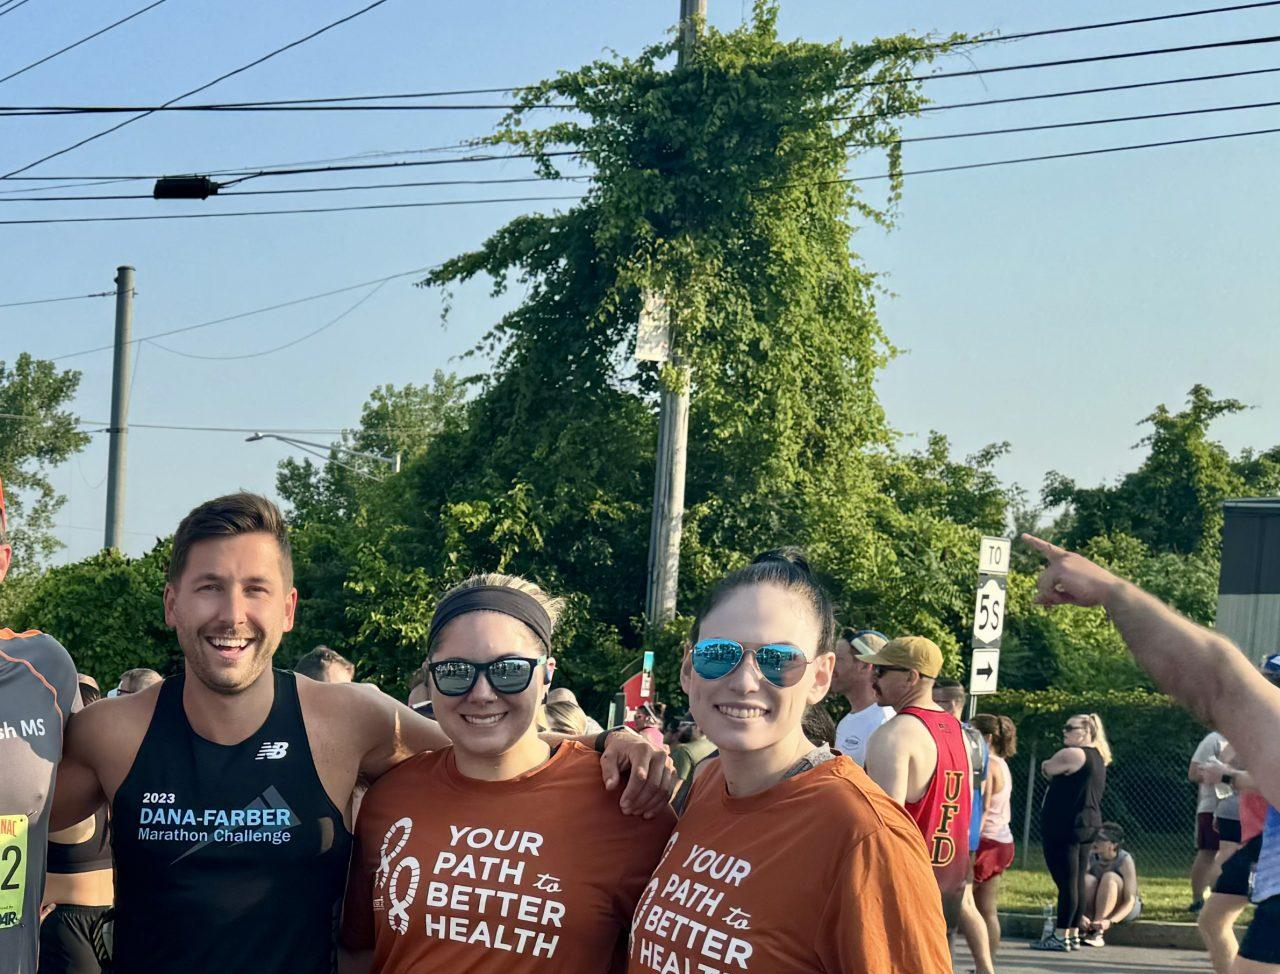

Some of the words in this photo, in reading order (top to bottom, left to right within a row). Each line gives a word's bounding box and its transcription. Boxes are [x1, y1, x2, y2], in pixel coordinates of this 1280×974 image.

[989, 545, 1001, 565] TO
[21, 718, 46, 737] MS
[142, 792, 176, 804] 2023
[139, 808, 291, 826] DANA-FARBER
[138, 828, 208, 842] Marathon
[214, 829, 291, 845] Challenge
[449, 825, 544, 857] YOUR
[433, 851, 526, 886] PATH
[532, 873, 562, 893] to
[682, 844, 752, 887] YOUR
[426, 881, 567, 928] BETTER
[660, 873, 725, 917] PATH
[721, 907, 752, 930] to
[425, 913, 560, 959] HEALTH
[644, 905, 753, 970] BETTER
